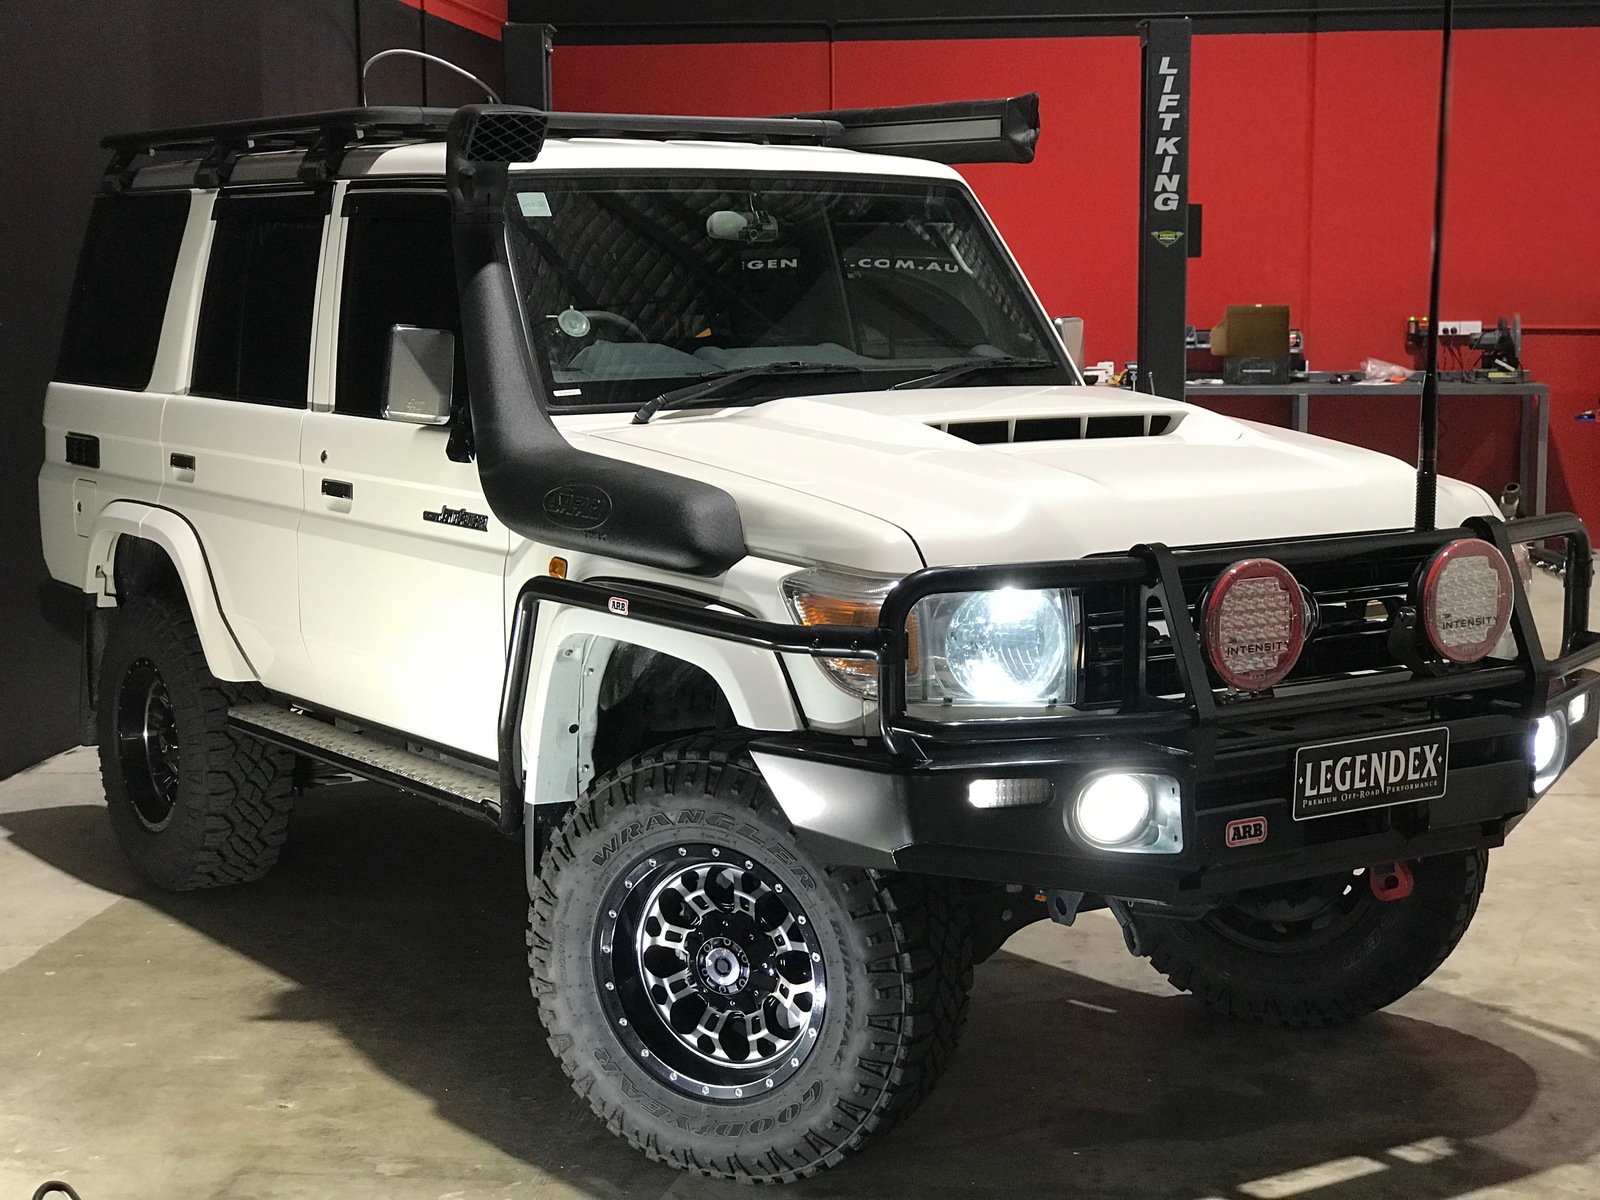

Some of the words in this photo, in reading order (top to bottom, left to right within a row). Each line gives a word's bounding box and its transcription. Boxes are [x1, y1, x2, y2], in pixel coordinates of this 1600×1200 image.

[1157, 56, 1181, 131] LIFT
[1153, 136, 1182, 211] KING
[742, 258, 798, 270] GEN
[843, 258, 959, 273] .COM.AU
[611, 600, 626, 611] ARB
[1442, 615, 1499, 630] INTENSITY
[1227, 641, 1291, 655] INTENSITY
[1304, 743, 1439, 797] LEGENDEX
[1302, 796, 1337, 808] PREMIUM
[1341, 789, 1380, 801] OFF-ROAD
[1386, 780, 1437, 794] PERFORMANCE
[1231, 822, 1263, 841] ARB
[591, 808, 817, 891] WRANGLER
[593, 1048, 823, 1138] GOODYEAR
